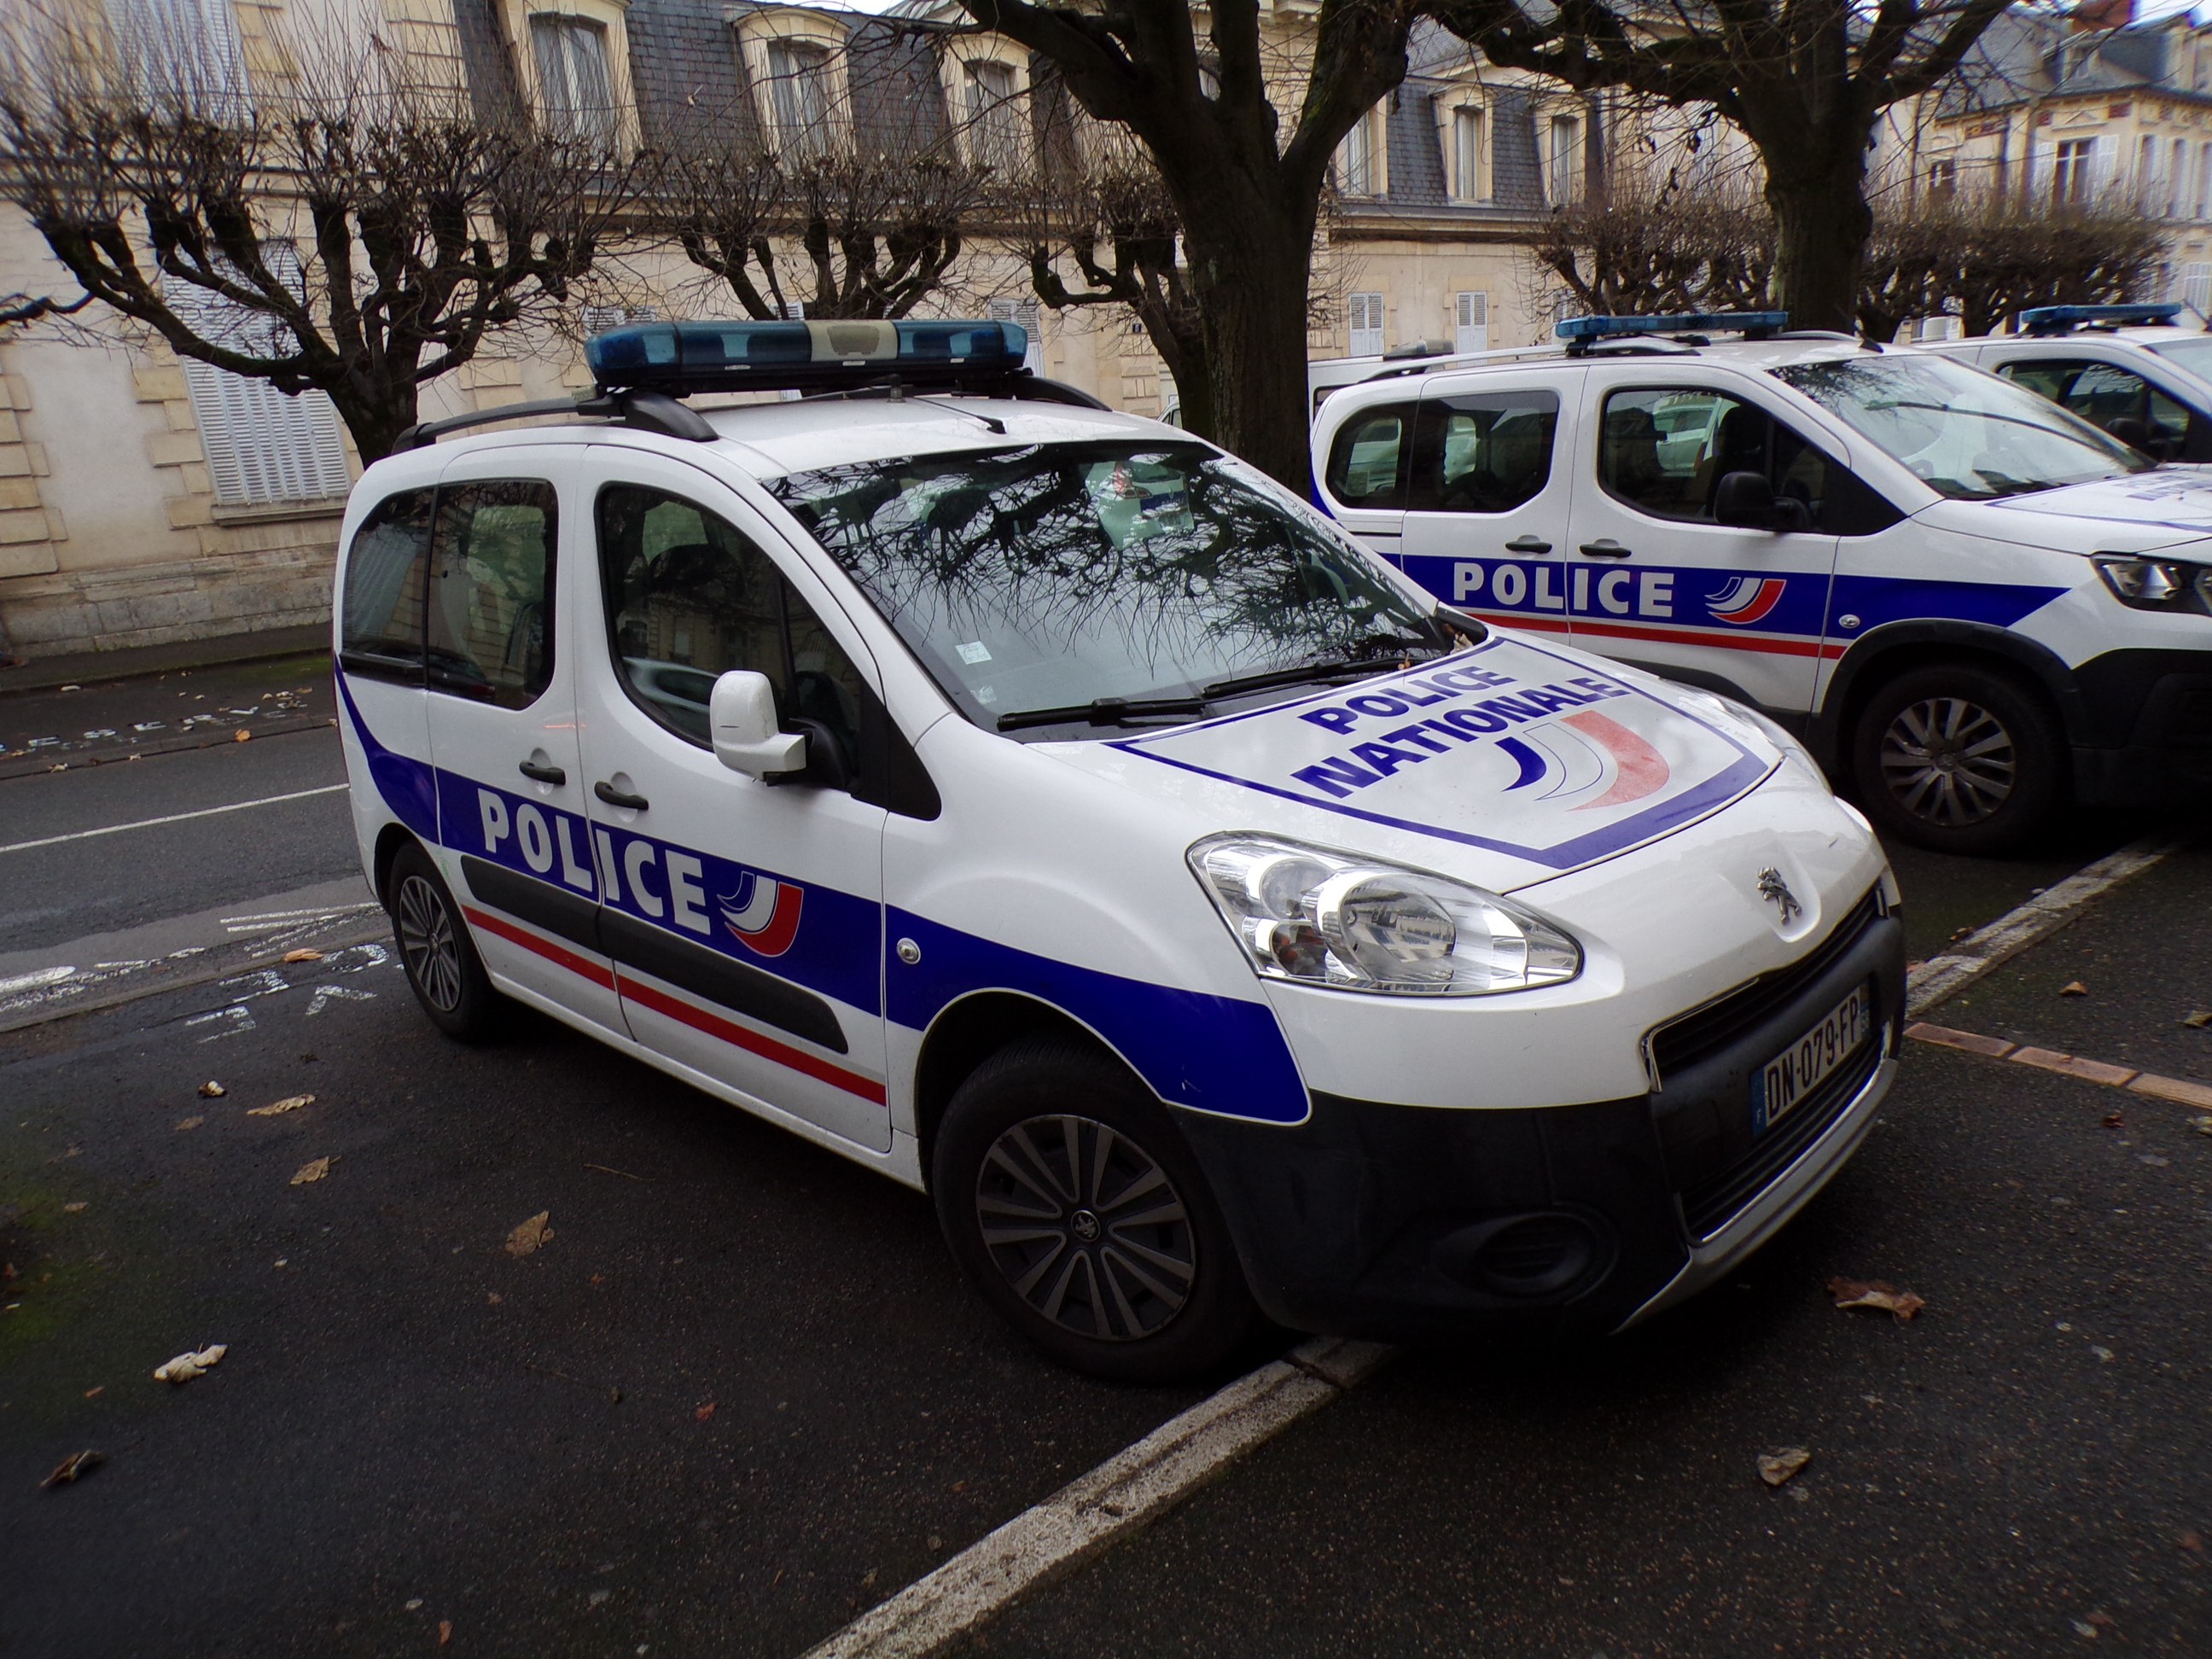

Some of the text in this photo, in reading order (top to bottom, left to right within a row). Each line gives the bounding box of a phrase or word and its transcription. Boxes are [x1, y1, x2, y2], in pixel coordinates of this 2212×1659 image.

[1452, 561, 1675, 618] POLICE
[1289, 676, 1632, 799] NATIONALE
[1297, 665, 1518, 736] POLICE
[477, 787, 711, 935] POLICE
